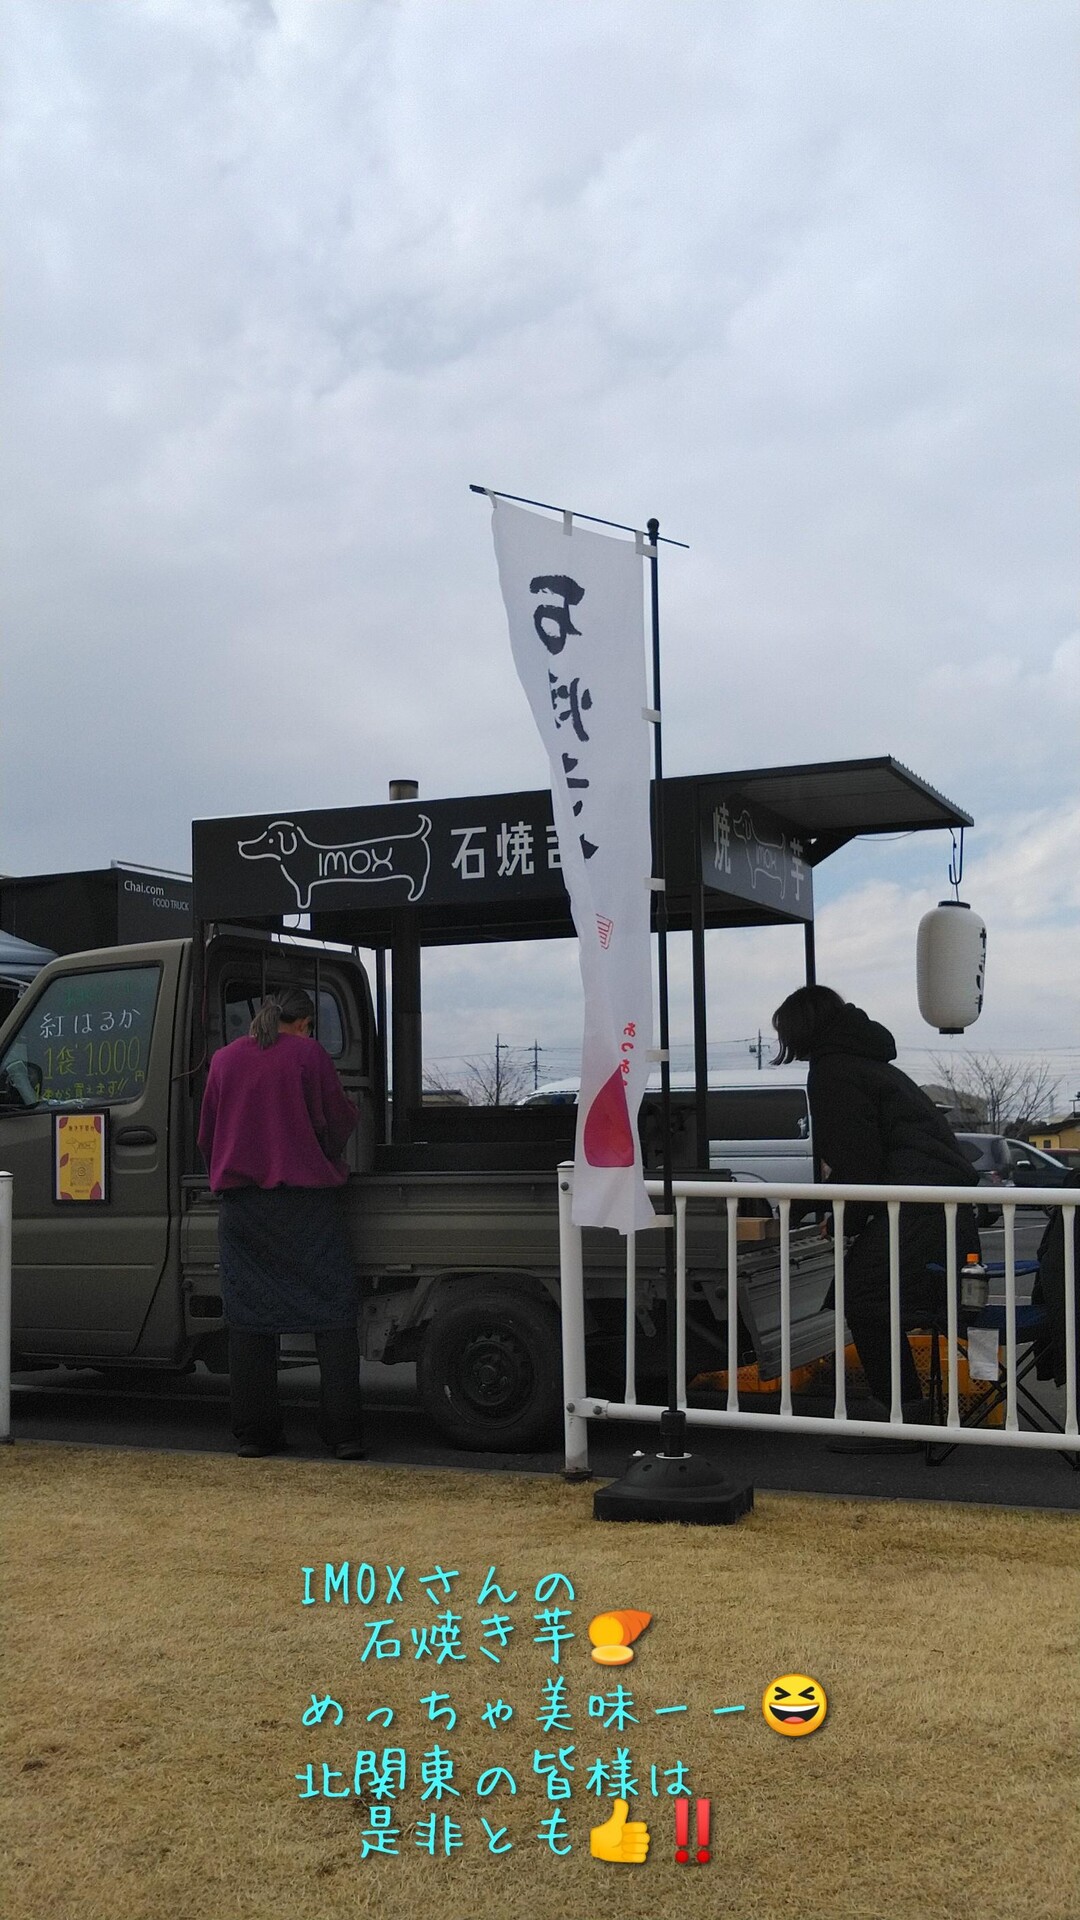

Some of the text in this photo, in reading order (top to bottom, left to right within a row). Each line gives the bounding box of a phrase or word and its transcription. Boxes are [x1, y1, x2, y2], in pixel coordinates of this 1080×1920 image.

[318, 846, 393, 877] IMOX
[124, 880, 164, 896] Chai.com
[152, 897, 190, 911] FOOD TRUCK
[40, 1008, 141, 1039] 紅はるか
